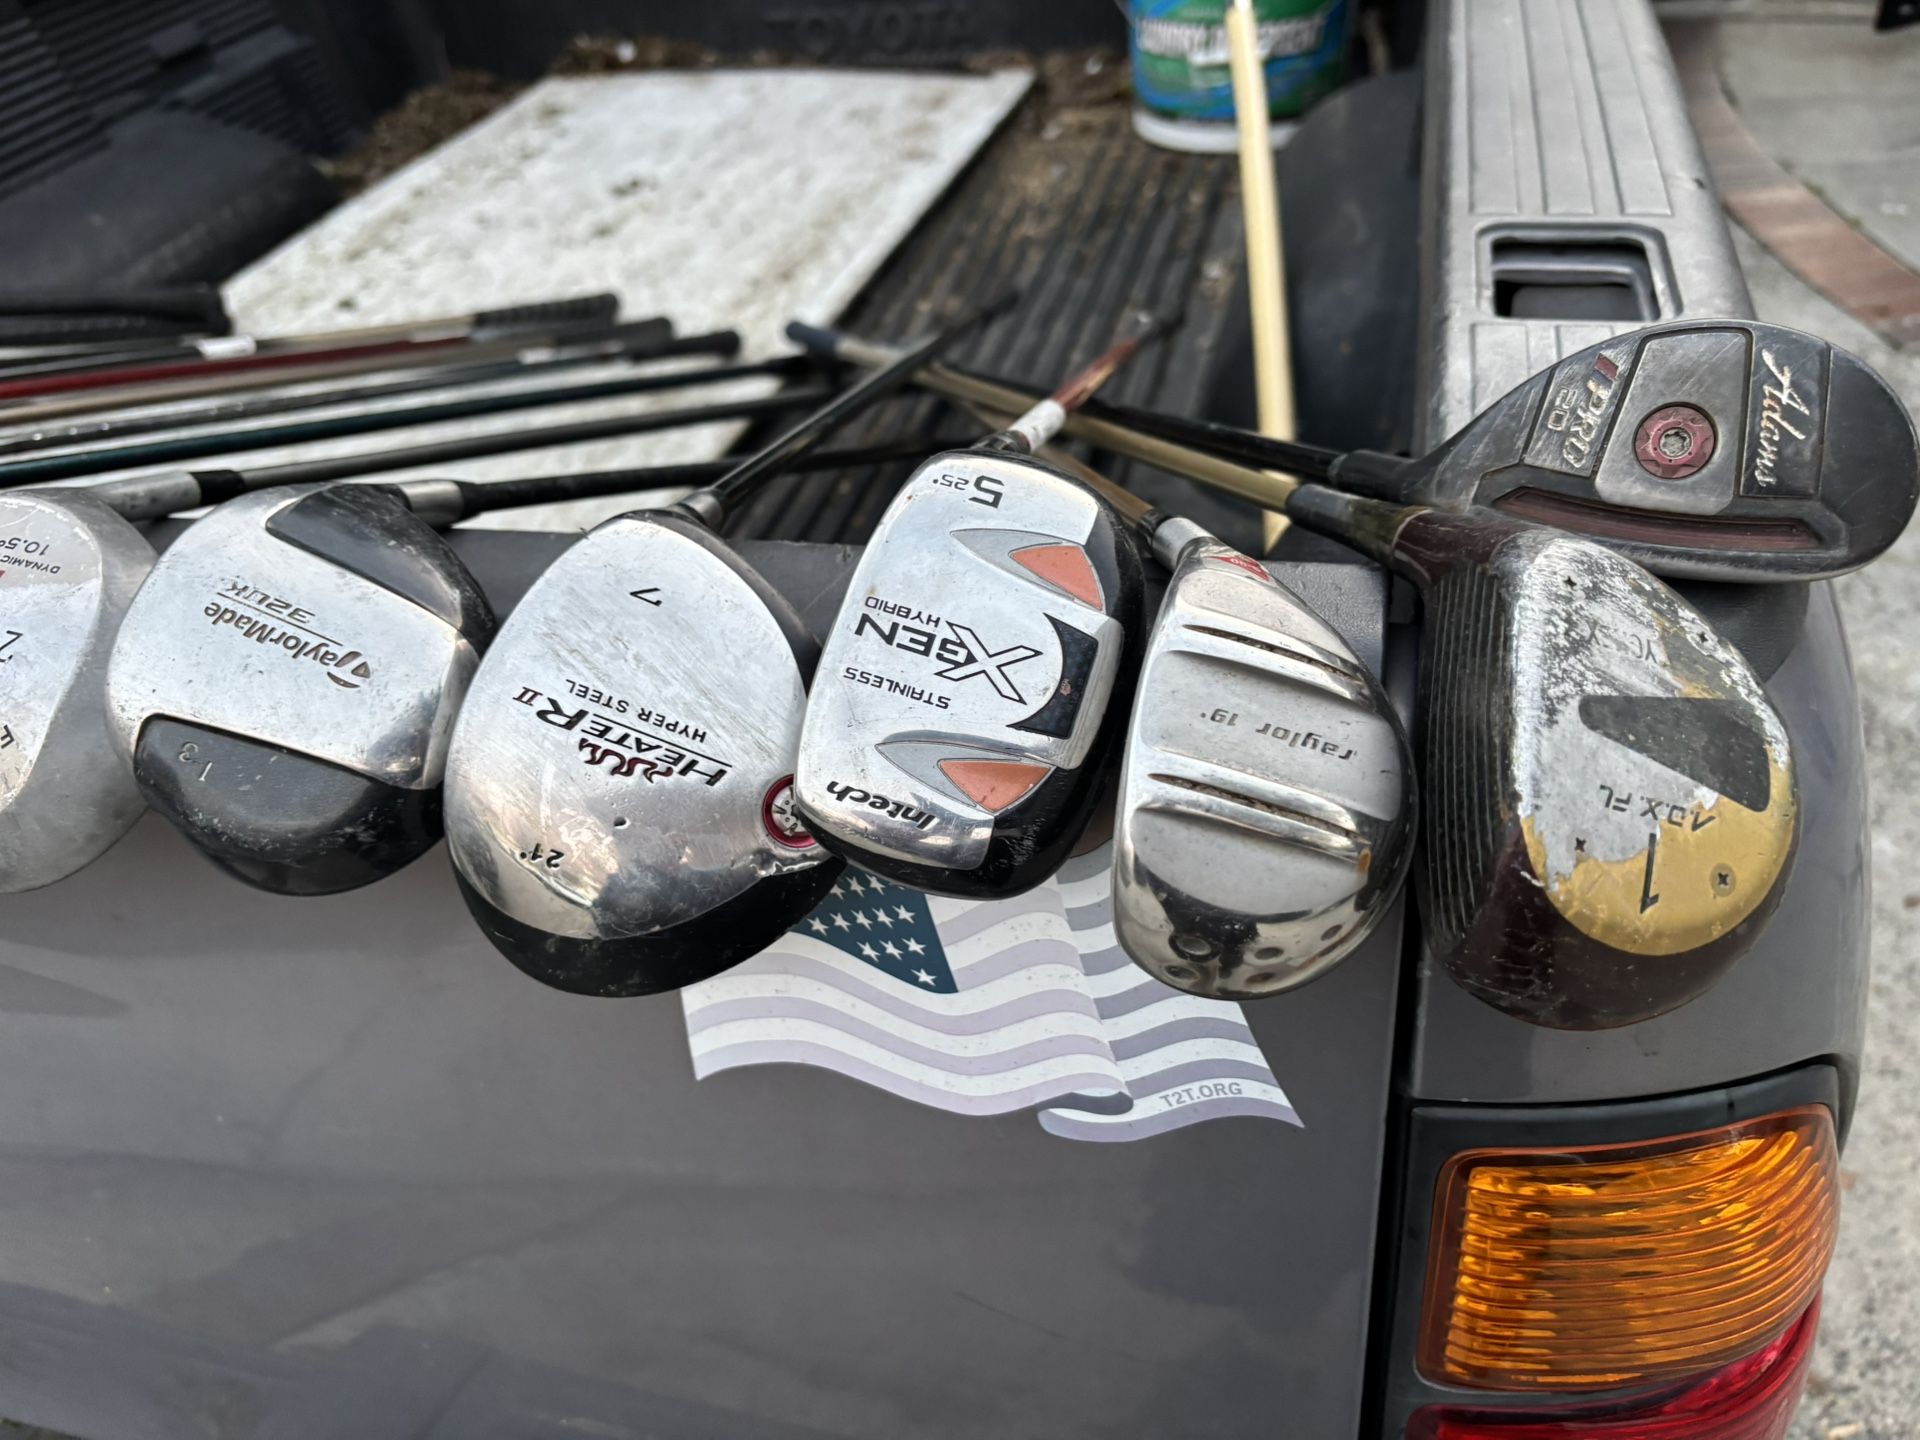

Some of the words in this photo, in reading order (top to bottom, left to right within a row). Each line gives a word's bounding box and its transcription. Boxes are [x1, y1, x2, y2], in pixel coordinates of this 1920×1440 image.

[1547, 386, 1577, 431] 20
[1754, 349, 1810, 488] Adams
[968, 475, 1005, 509] 5
[0, 554, 61, 574] DYNAMIC
[629, 587, 663, 607] 7
[864, 596, 941, 628] HYBRID
[204, 601, 371, 689] TaylorMade
[565, 679, 630, 714] STEEL
[843, 667, 952, 710] STAINLESS
[536, 697, 728, 787] HEATER
[637, 707, 707, 744] HYPER
[826, 780, 938, 830] Intech
[1639, 832, 1660, 915] 1
[1160, 1082, 1243, 1108] T2T.ORG
